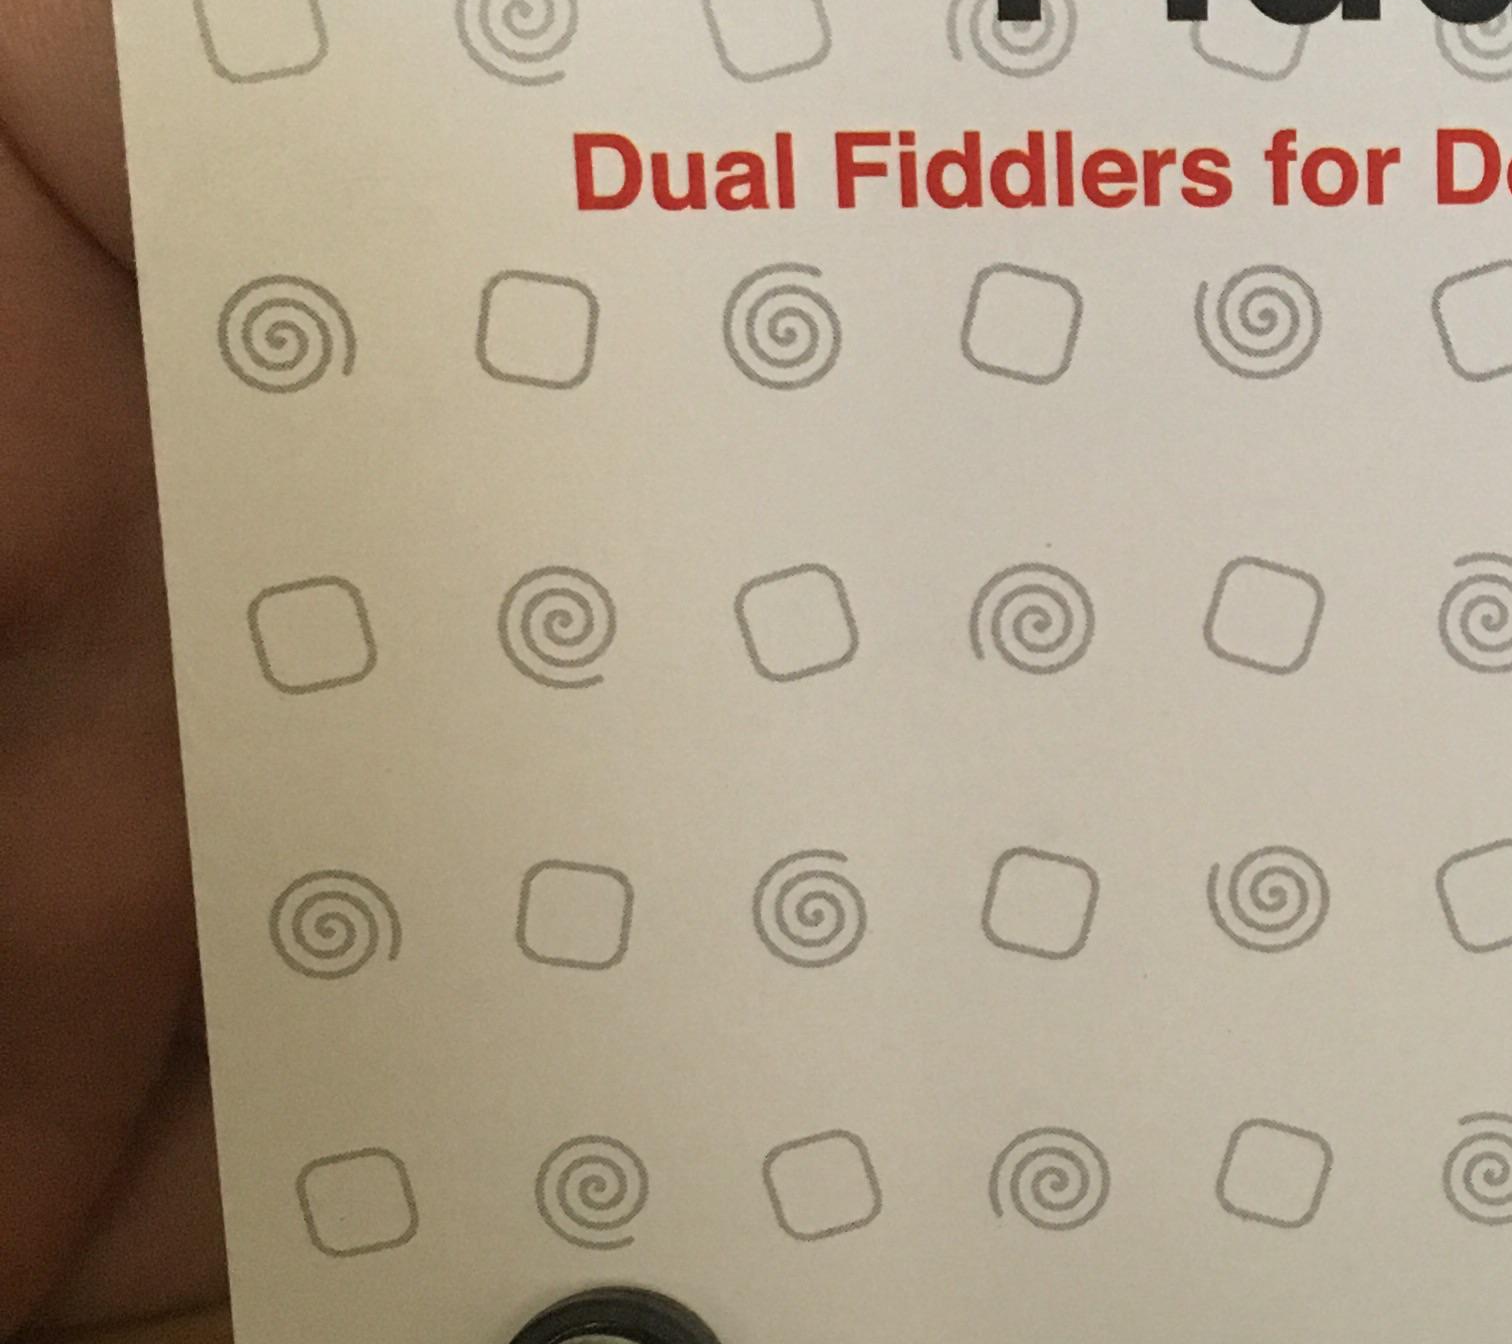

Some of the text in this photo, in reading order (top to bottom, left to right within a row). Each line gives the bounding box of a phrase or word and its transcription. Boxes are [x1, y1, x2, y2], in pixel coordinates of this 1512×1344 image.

[572, 131, 796, 212] Dual
[834, 128, 1234, 209] Fiddlers
[1263, 127, 1402, 207] for
